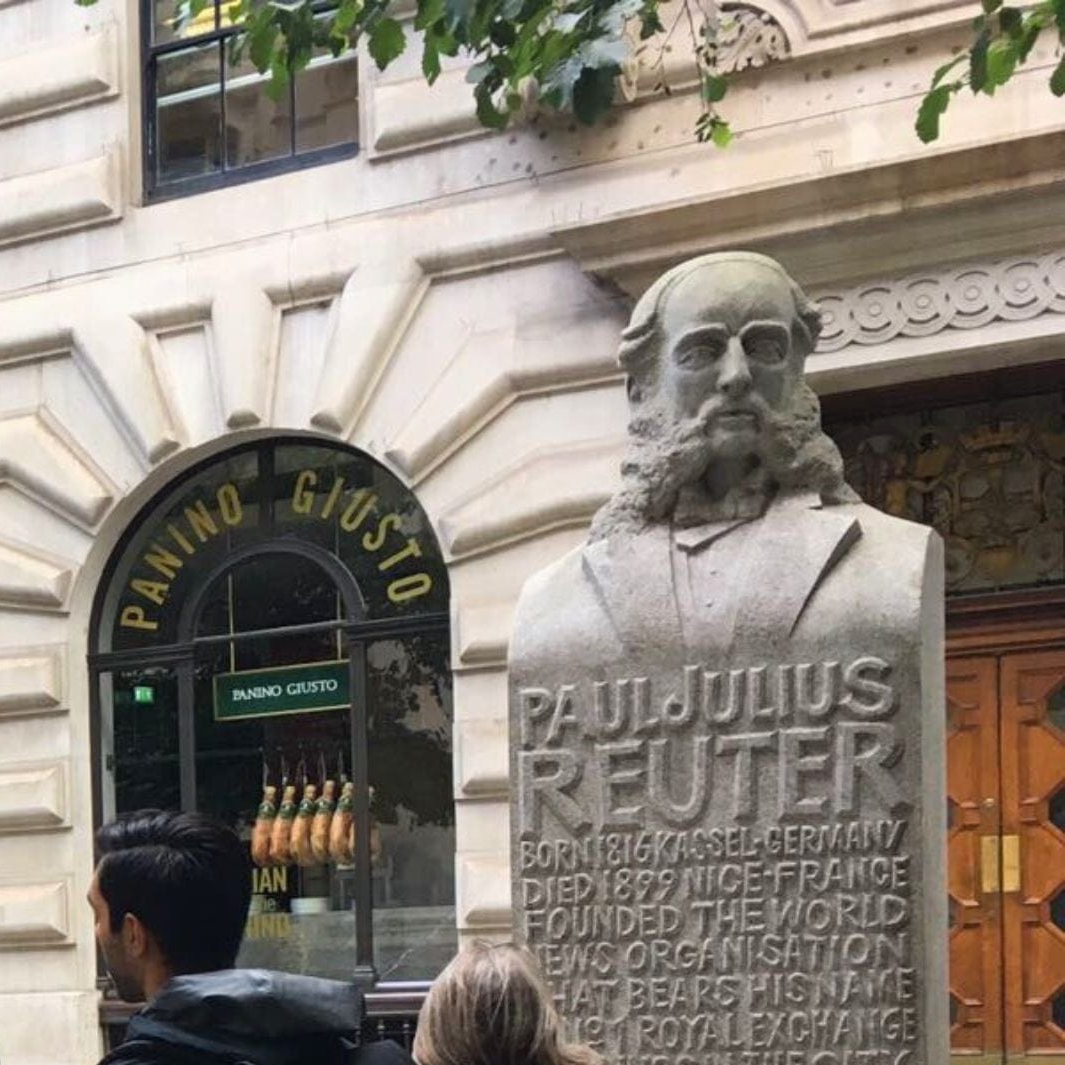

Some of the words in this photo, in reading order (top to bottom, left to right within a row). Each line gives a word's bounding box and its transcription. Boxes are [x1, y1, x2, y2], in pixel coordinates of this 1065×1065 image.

[120, 484, 243, 630] PANINO
[292, 470, 432, 602] GIUSTO
[232, 684, 282, 701] PANINO
[286, 678, 338, 697] GIUSTO
[519, 676, 659, 750] PAUL
[661, 656, 898, 729] JULIUS
[517, 722, 913, 837] REUTER
[521, 837, 591, 872] BORN
[598, 831, 651, 867] 1816
[521, 873, 594, 907] DIED
[602, 867, 676, 901] 1899
[525, 905, 682, 941] FOUNDED
[690, 898, 765, 934] THE
[771, 893, 907, 930] WORLD
[538, 941, 615, 974] EWS
[626, 933, 907, 970] ORGANISATION
[627, 975, 742, 1010] BEARS
[748, 972, 808, 1005] HIS
[813, 967, 915, 1004] NAME
[637, 1013, 742, 1051] ROYAL
[750, 1008, 915, 1047] EXCHANGE
